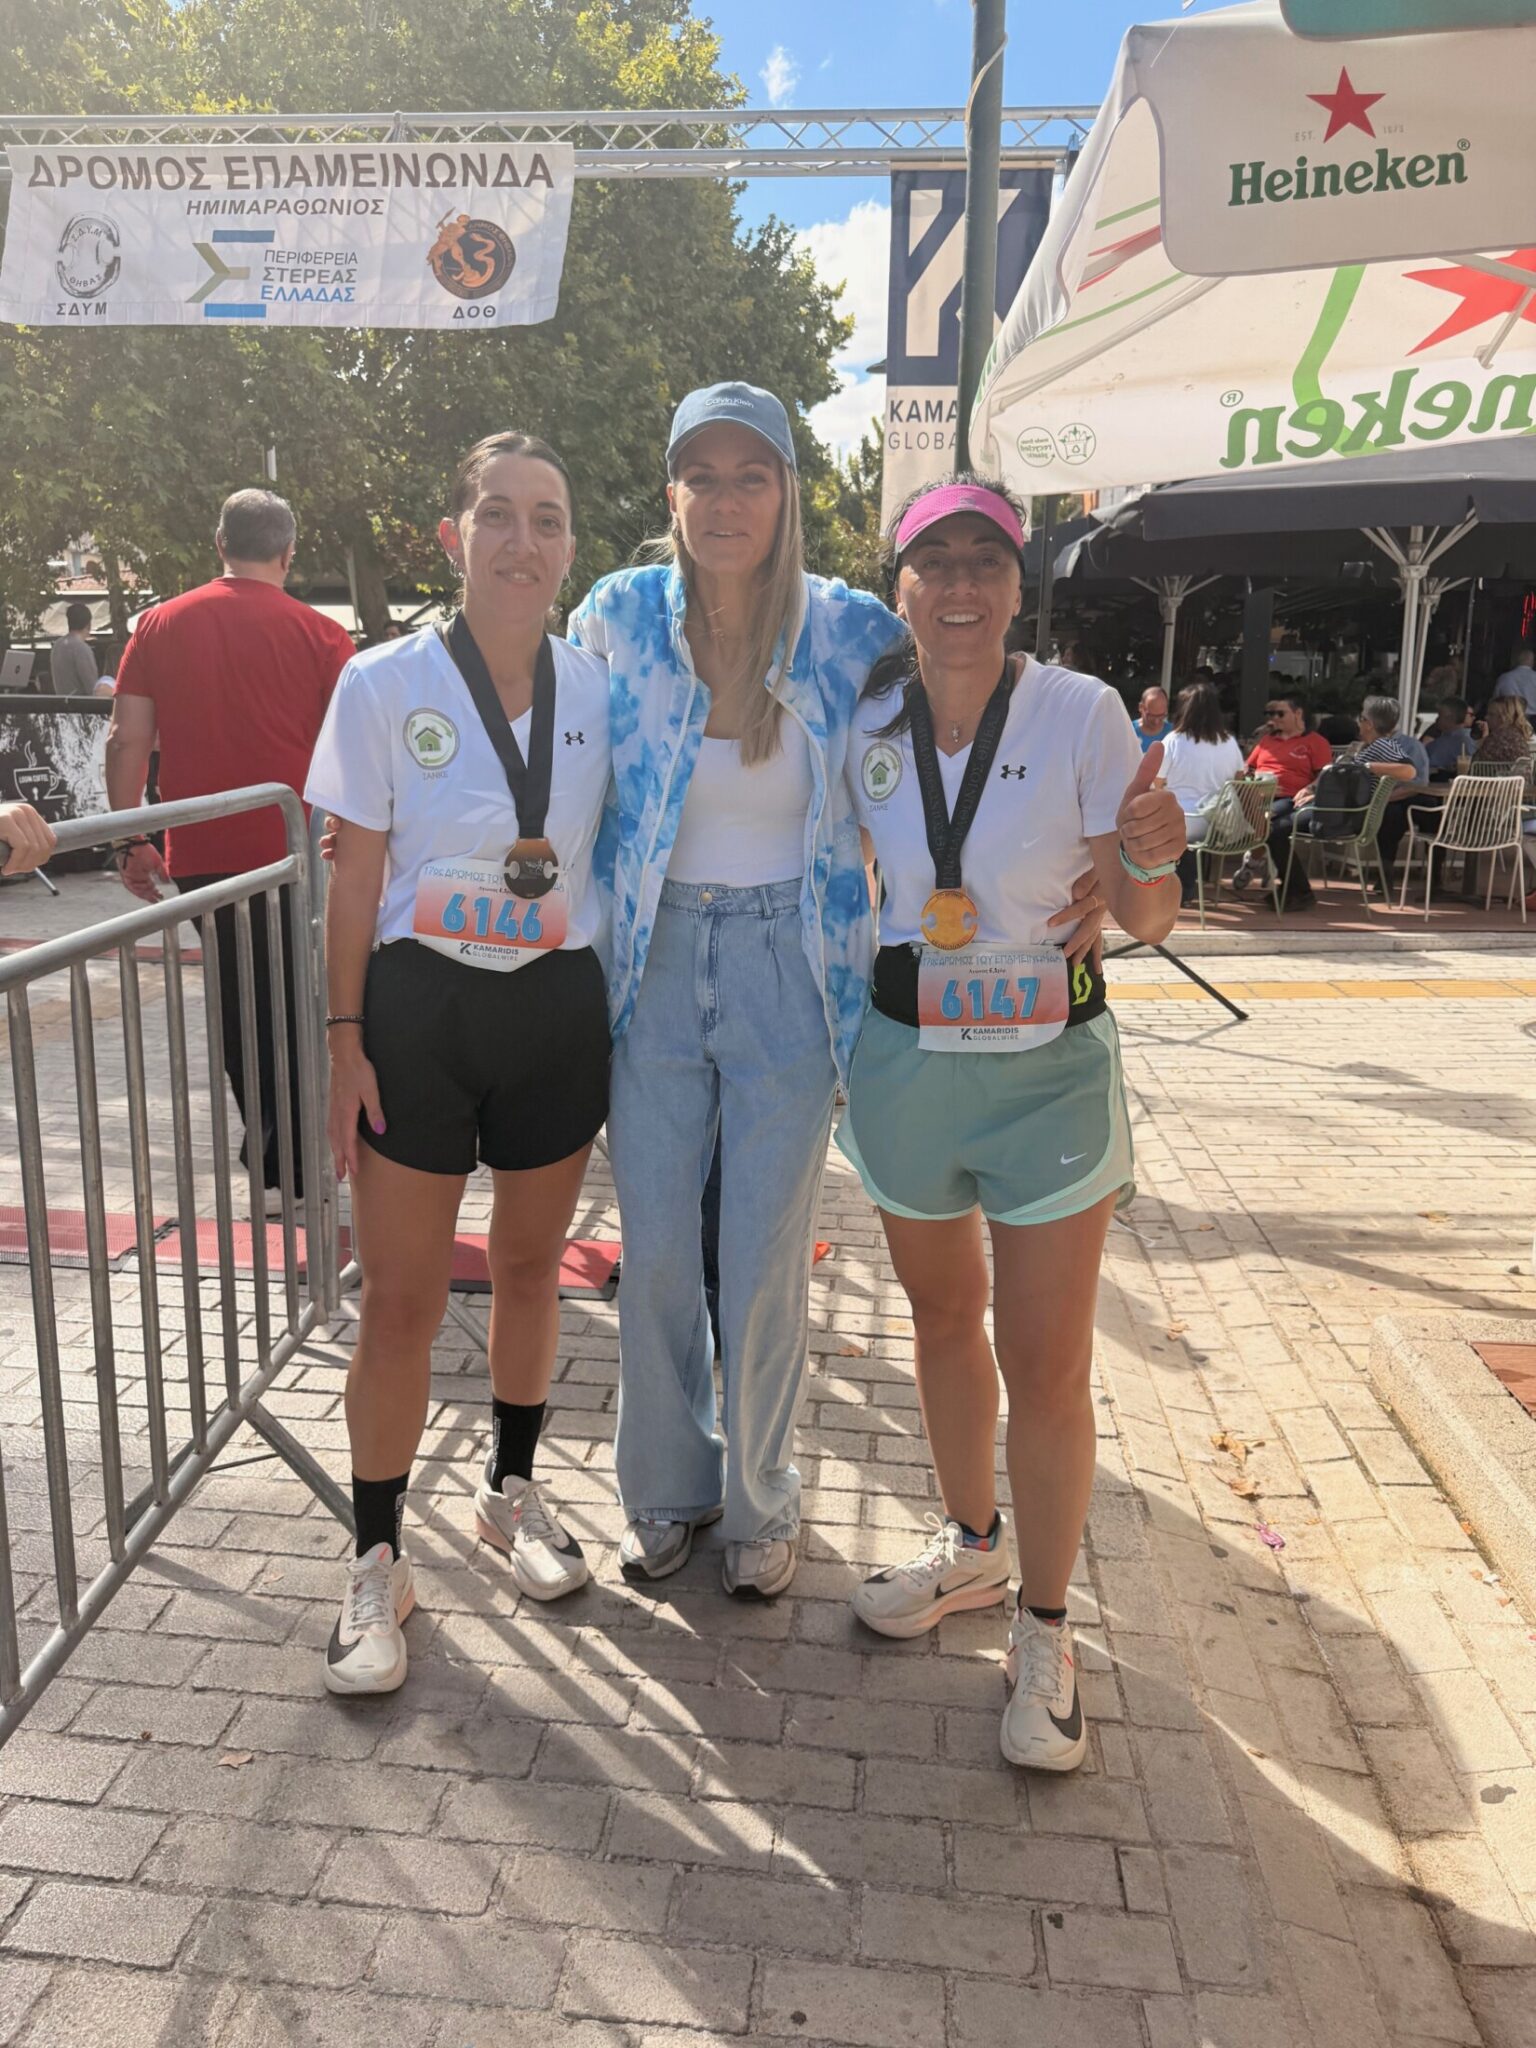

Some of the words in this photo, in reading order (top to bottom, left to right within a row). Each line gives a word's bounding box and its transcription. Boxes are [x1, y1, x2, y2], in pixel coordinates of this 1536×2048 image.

[28, 155, 212, 190] ΔΡΟΜΟΣ
[223, 153, 555, 190] ΕΠΑΜΕΙΝΩΝΔΑ
[186, 198, 384, 216] ΗΜΙΜΑΡΑΘΩΝΙΟΣ
[264, 249, 358, 265] ΠΕΡΙΦΕΡΕΙΑ
[69, 274, 103, 287] ΘΗΒΑΣ
[262, 266, 357, 284] ΣΤΕΡΕΑΣ
[261, 285, 356, 302] ΕΛΛΑΔΑΣ
[56, 302, 107, 315] ΣΔΥΜ
[452, 305, 496, 319] ΔΟΘ
[441, 892, 543, 942] 6146
[473, 943, 519, 955] KAMARIDIS
[940, 976, 1040, 1020] 6147
[973, 1027, 1019, 1035] KAMARIDIS
